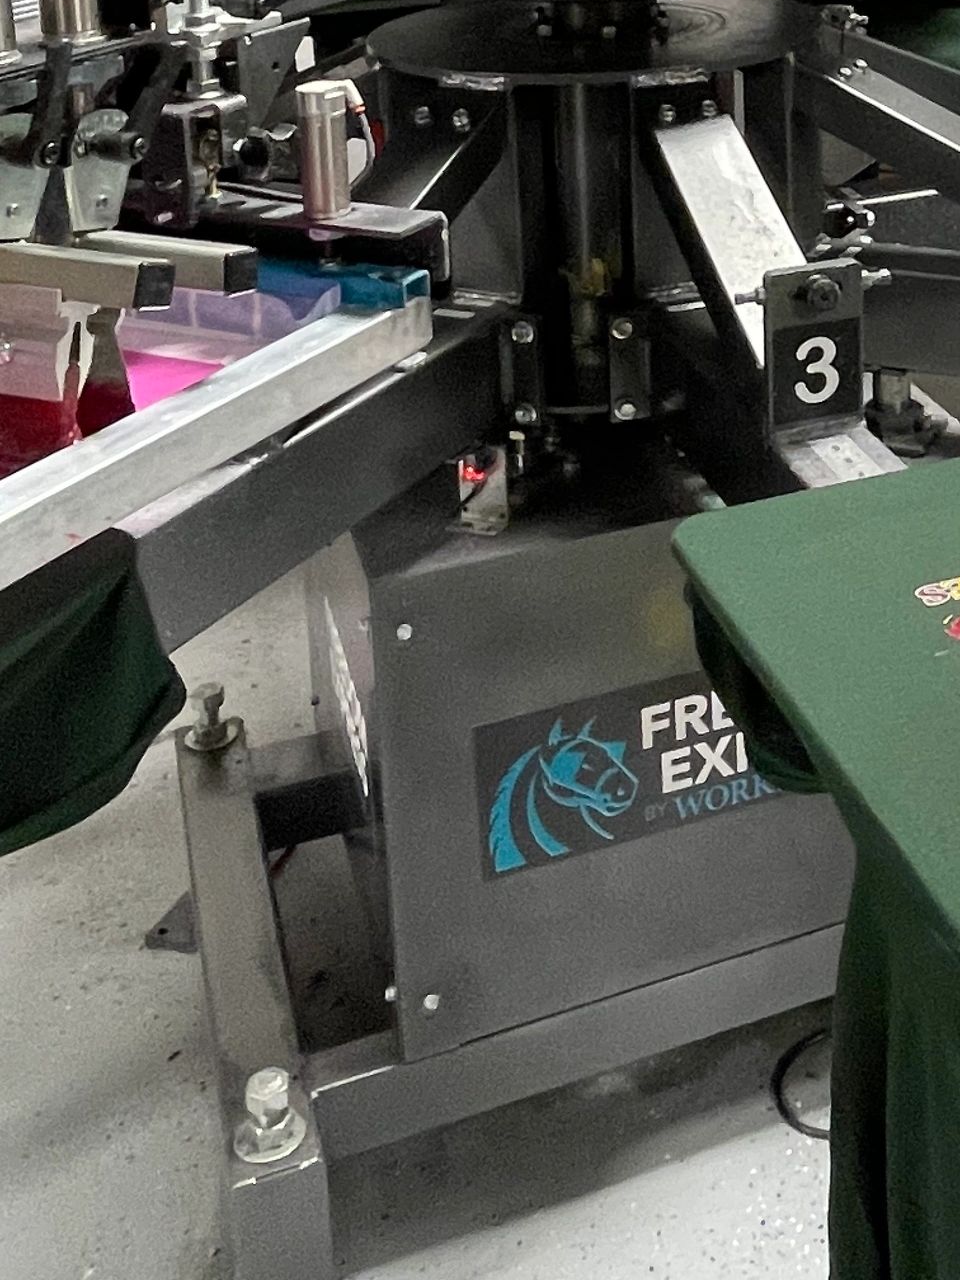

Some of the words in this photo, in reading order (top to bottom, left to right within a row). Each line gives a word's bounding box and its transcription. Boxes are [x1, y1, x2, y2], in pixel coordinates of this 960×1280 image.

[794, 336, 840, 404] 3
[644, 801, 668, 822] BY
[673, 773, 781, 820] WORK
